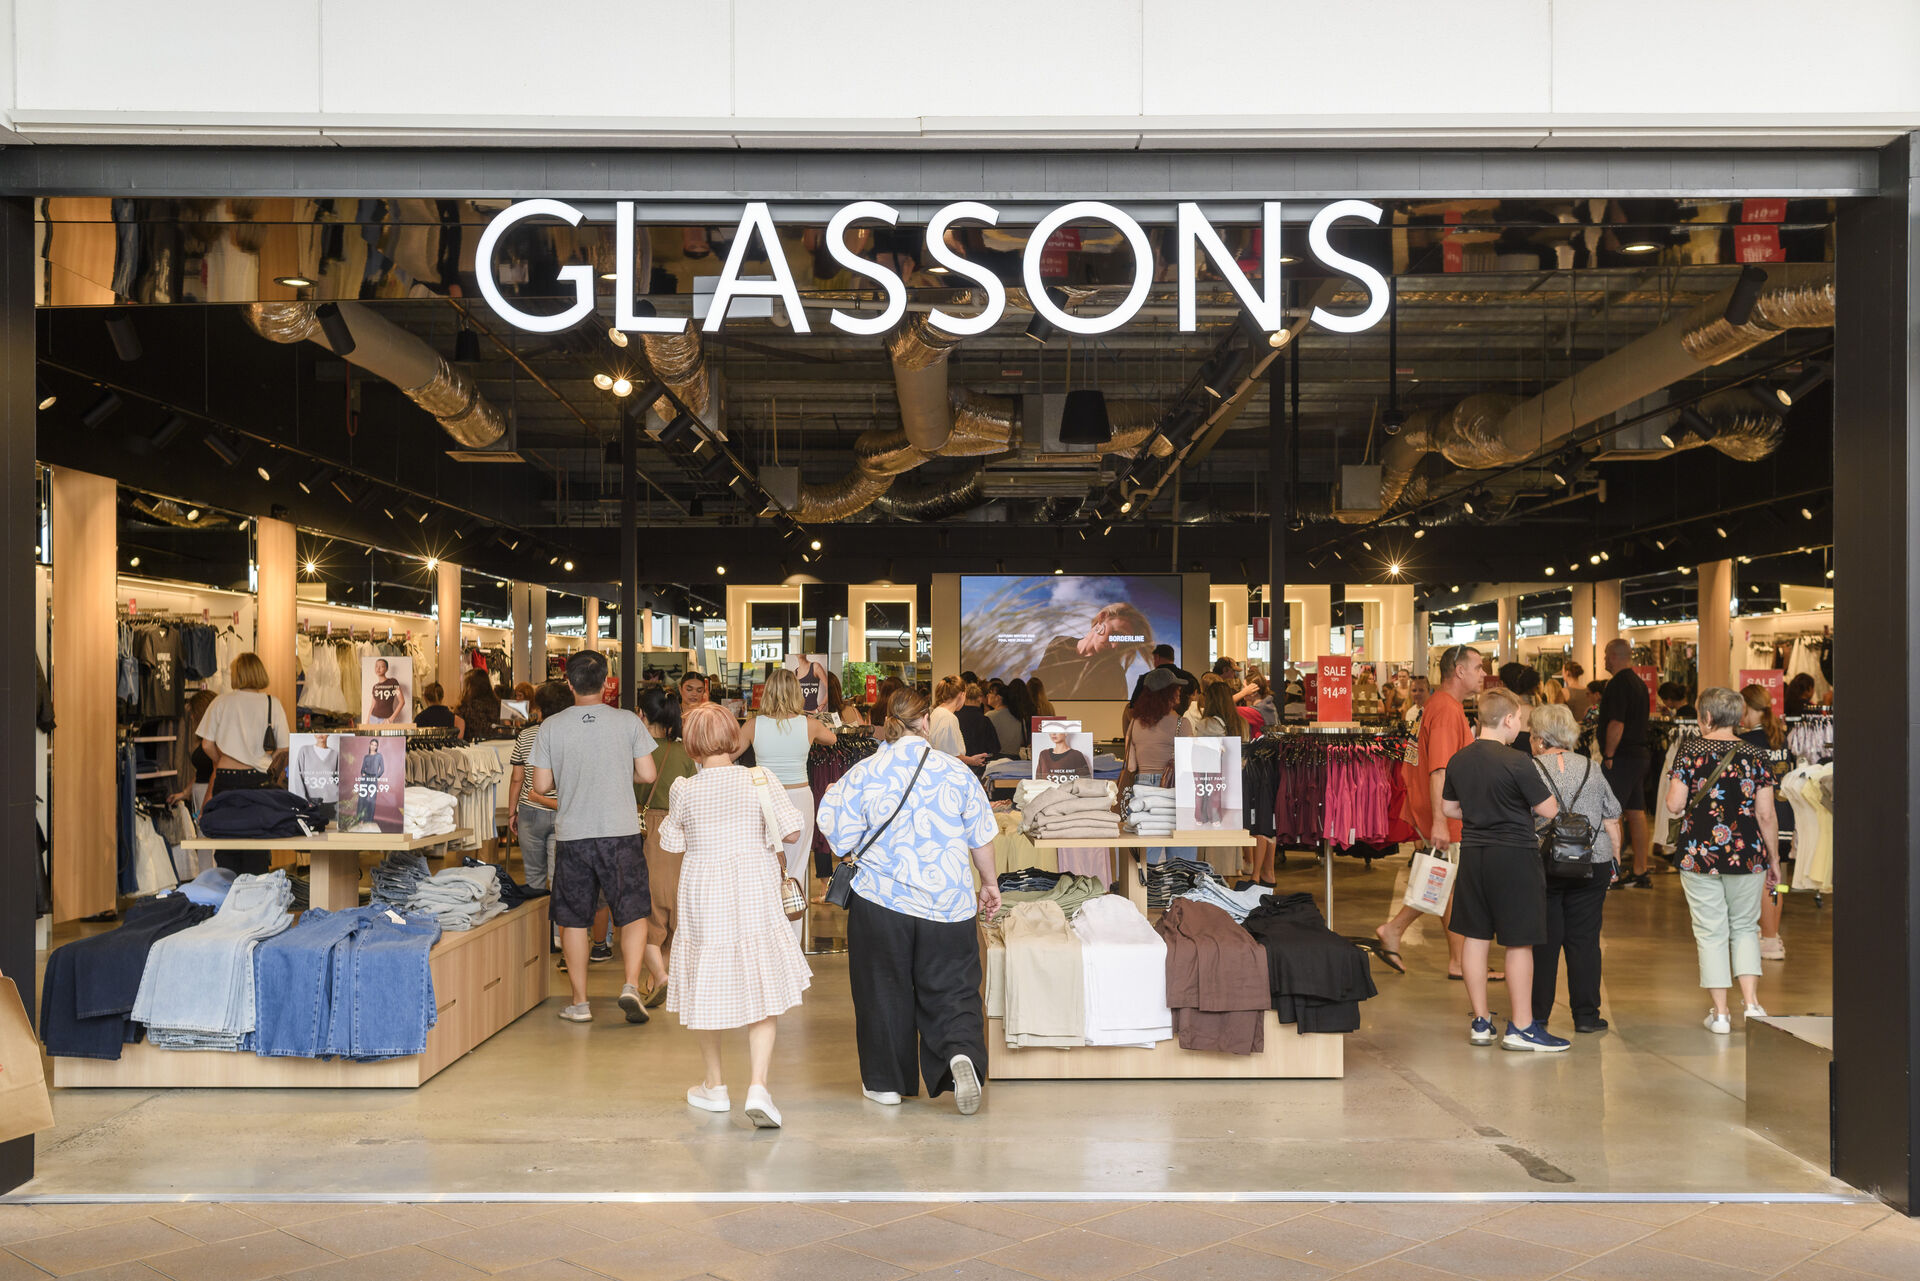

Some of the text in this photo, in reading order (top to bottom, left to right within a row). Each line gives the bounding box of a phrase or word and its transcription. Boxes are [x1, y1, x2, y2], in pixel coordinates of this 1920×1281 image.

[475, 198, 1391, 335] GLASSONS
[1323, 665, 1347, 676] SALE
[1323, 686, 1347, 698] $14.99
[304, 776, 339, 789] $39.99
[353, 783, 390, 798] $59.99
[1192, 783, 1227, 797] 39.99
